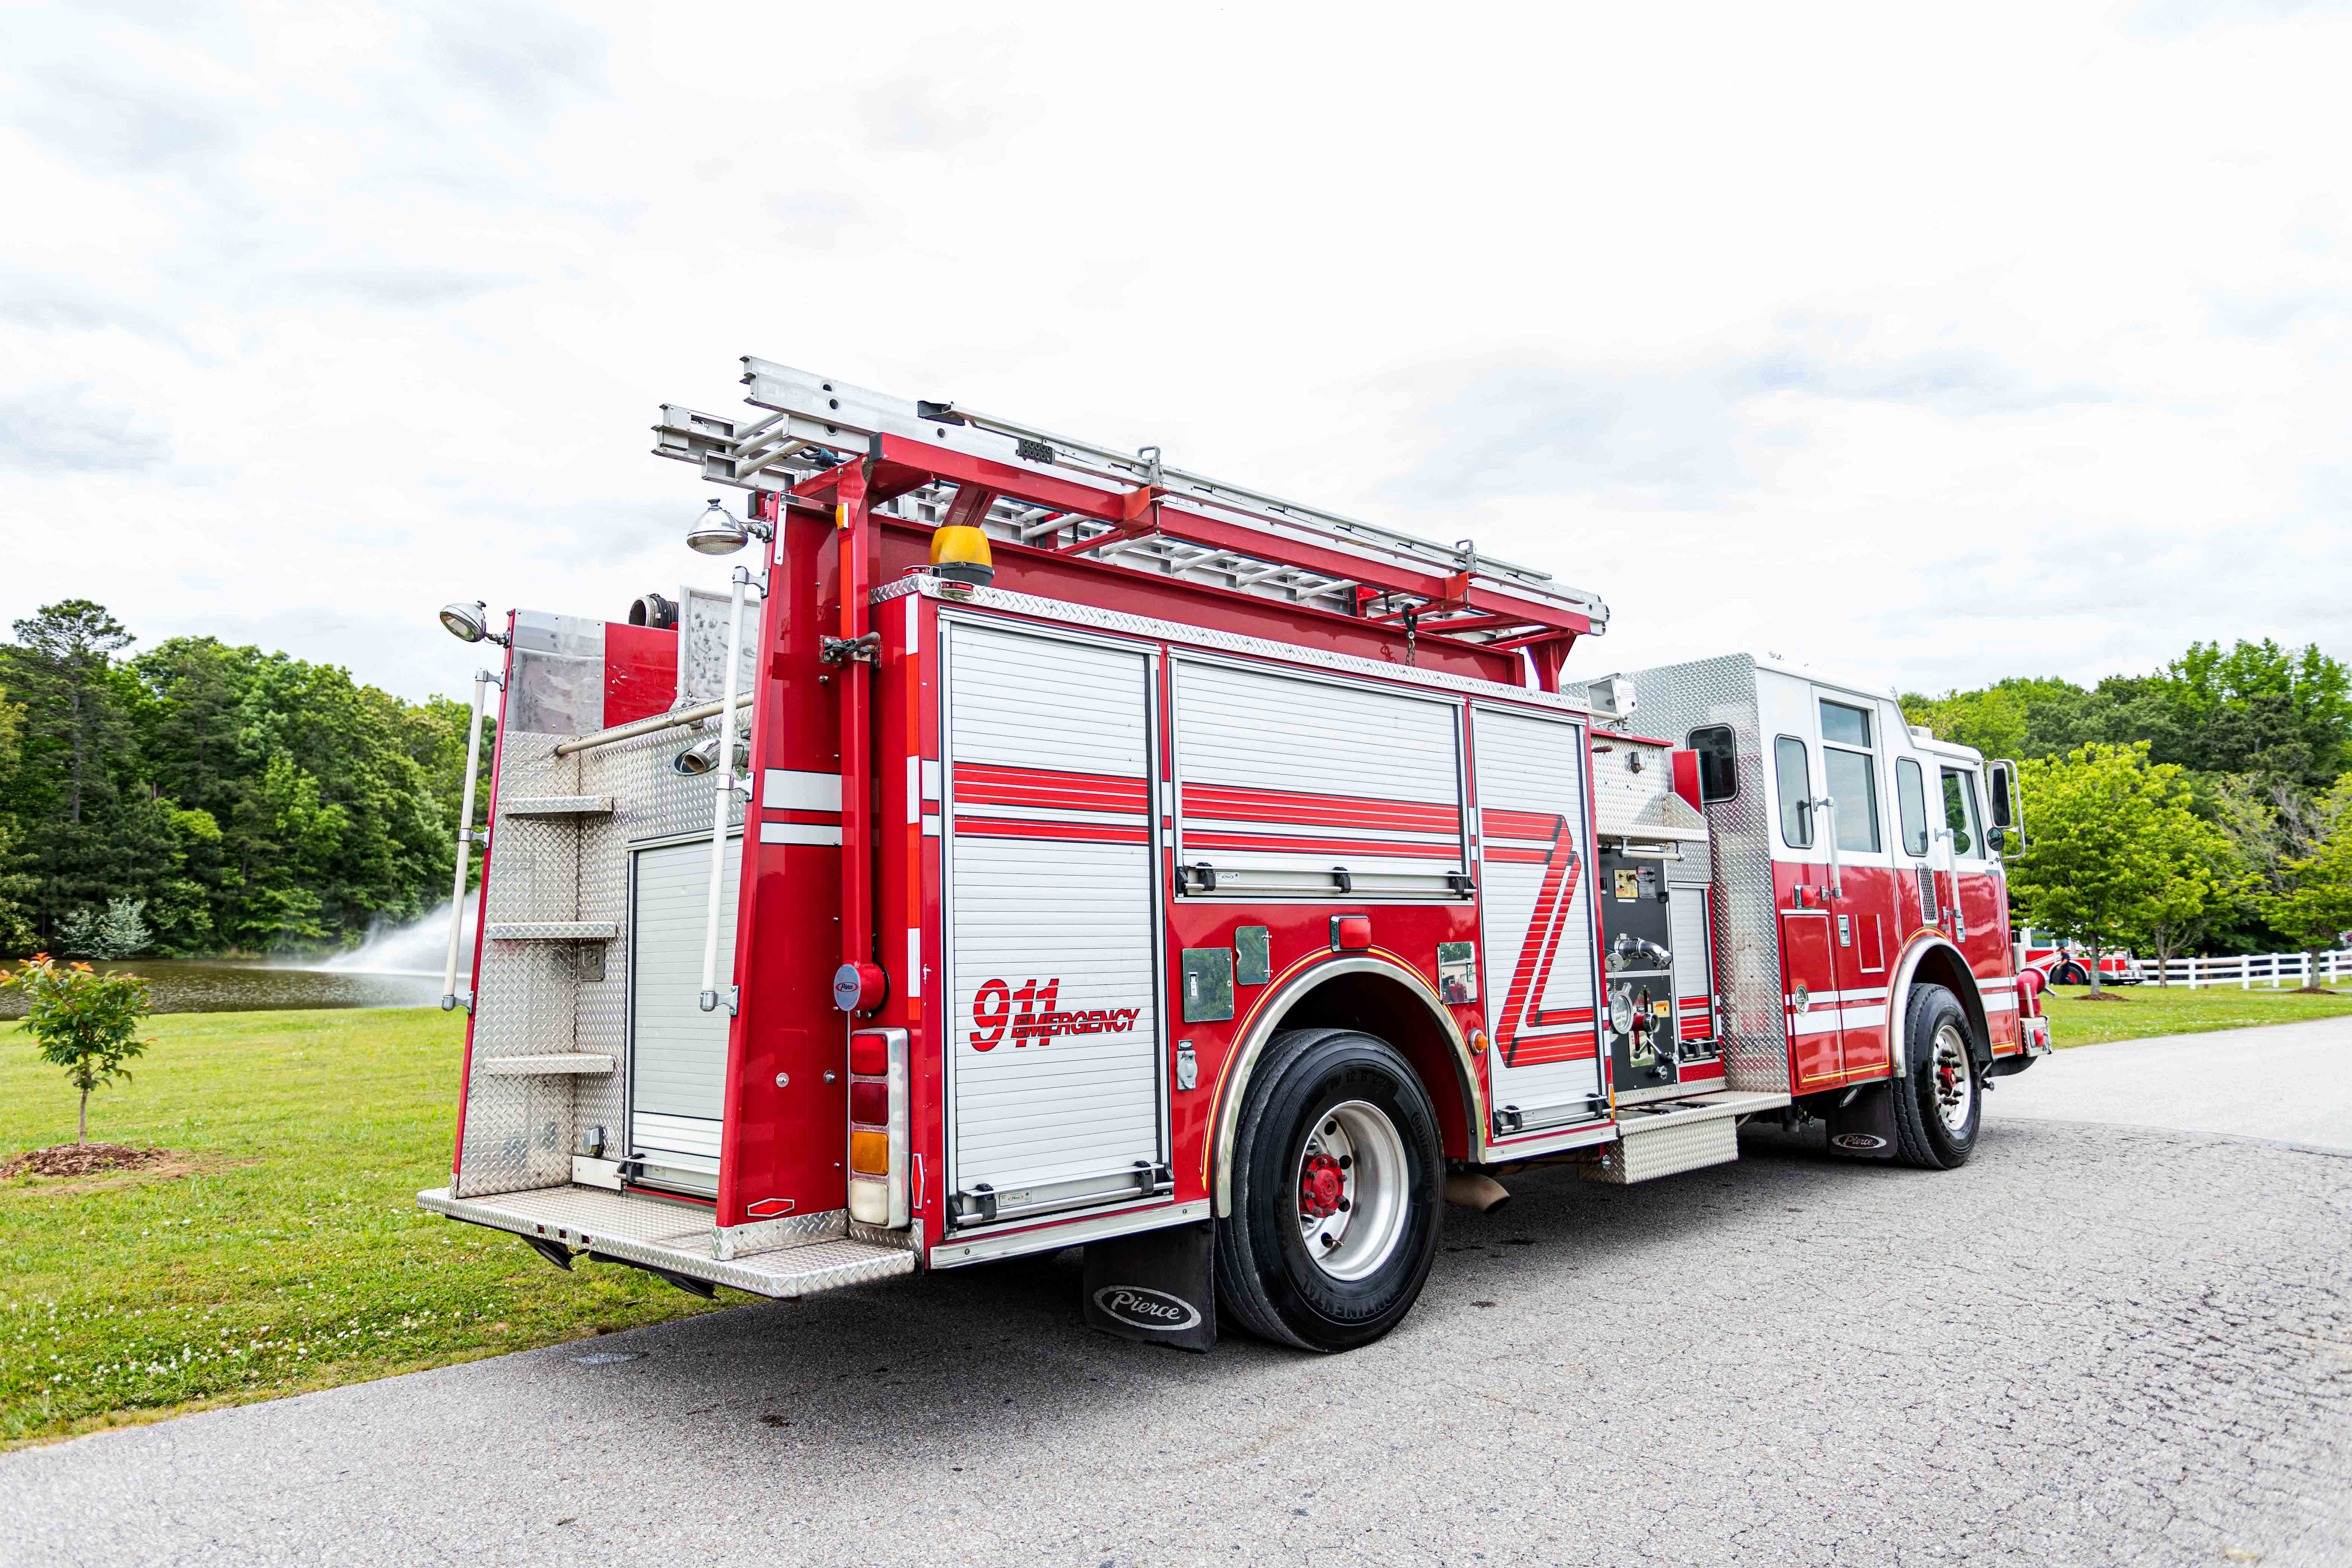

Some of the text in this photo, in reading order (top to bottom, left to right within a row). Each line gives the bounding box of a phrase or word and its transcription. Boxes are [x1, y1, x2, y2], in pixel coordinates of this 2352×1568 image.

[970, 978, 1060, 1052] 911
[1011, 1009, 1140, 1038] EMERGENCY
[1843, 1135, 1873, 1145] Pierce
[1111, 1291, 1180, 1319] Pierce
